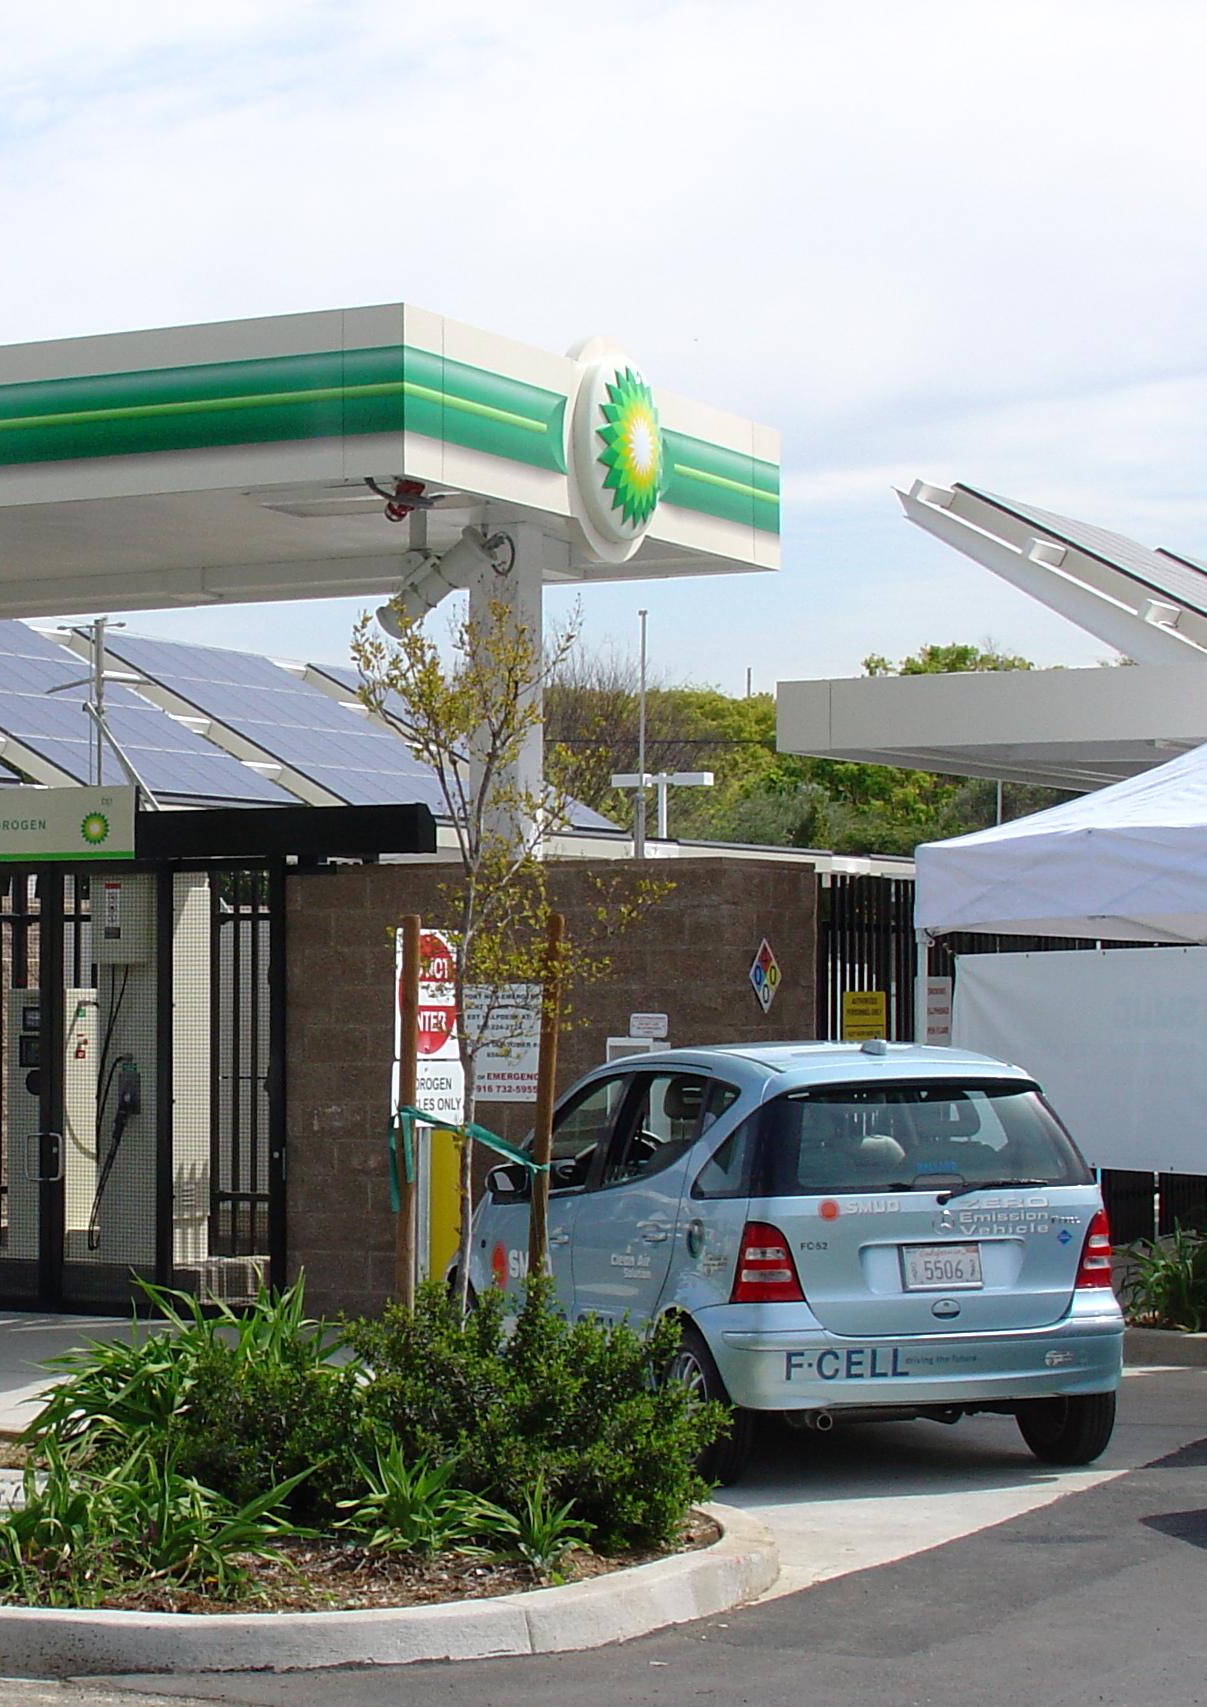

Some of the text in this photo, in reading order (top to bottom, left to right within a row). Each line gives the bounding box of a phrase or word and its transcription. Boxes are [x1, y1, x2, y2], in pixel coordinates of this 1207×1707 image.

[476, 1084, 493, 1093] 916
[437, 1097, 462, 1111] ONLY
[846, 1200, 900, 1214] SMUD
[959, 1196, 1049, 1210] ZERO
[960, 1209, 1049, 1223] Emission
[960, 1222, 1049, 1235] Vehicle
[924, 1259, 964, 1281] 5506
